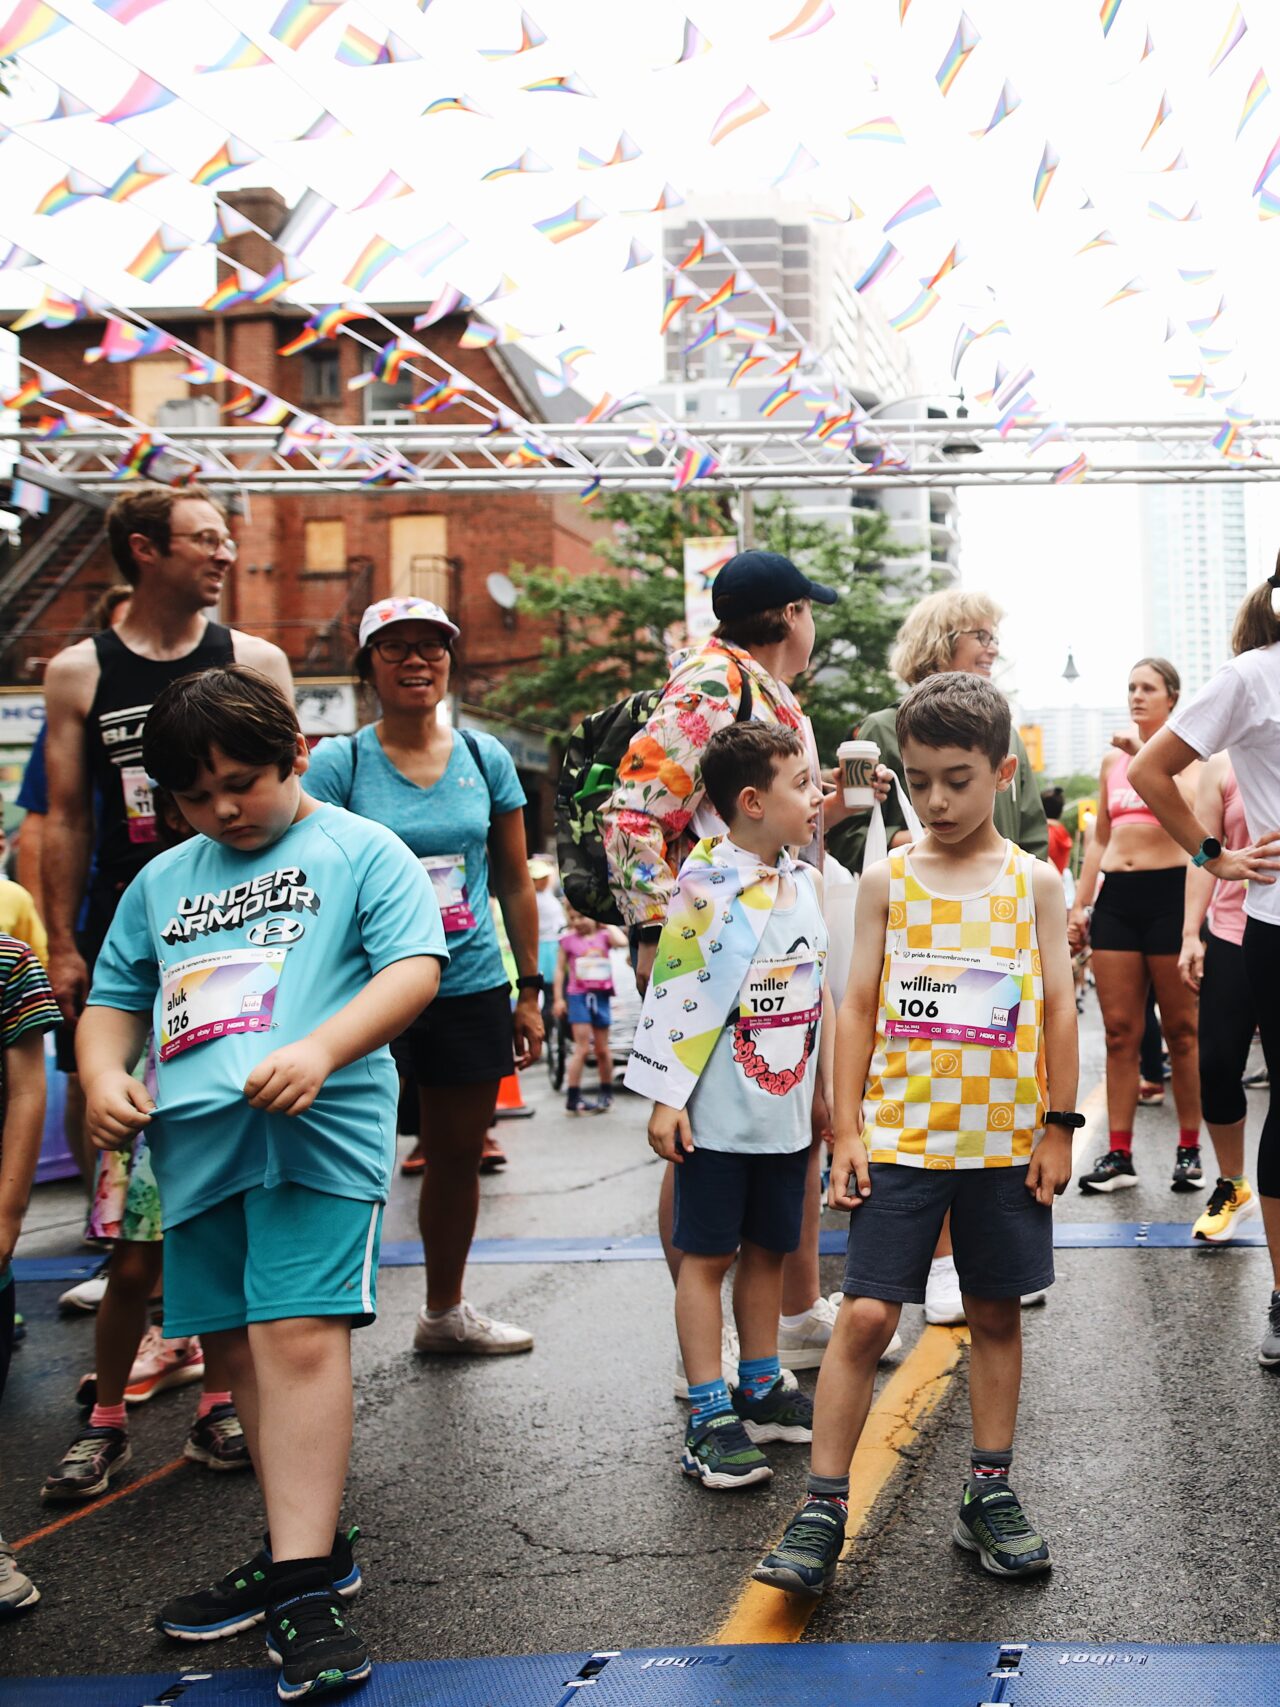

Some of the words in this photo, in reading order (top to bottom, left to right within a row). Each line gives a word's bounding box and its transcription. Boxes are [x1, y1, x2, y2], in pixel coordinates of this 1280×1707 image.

[176, 866, 302, 916] UNDER
[160, 884, 316, 940] ARMOUR
[931, 954, 970, 963] remembrance
[750, 977, 789, 991] miller
[900, 975, 957, 994] william
[167, 987, 187, 1011] aluk
[750, 997, 785, 1013] 107
[898, 998, 939, 1018] 106
[167, 1011, 189, 1037] 126
[994, 1013, 1007, 1022] kids
[946, 1028, 962, 1036] ebay
[652, 1060, 669, 1072] run
